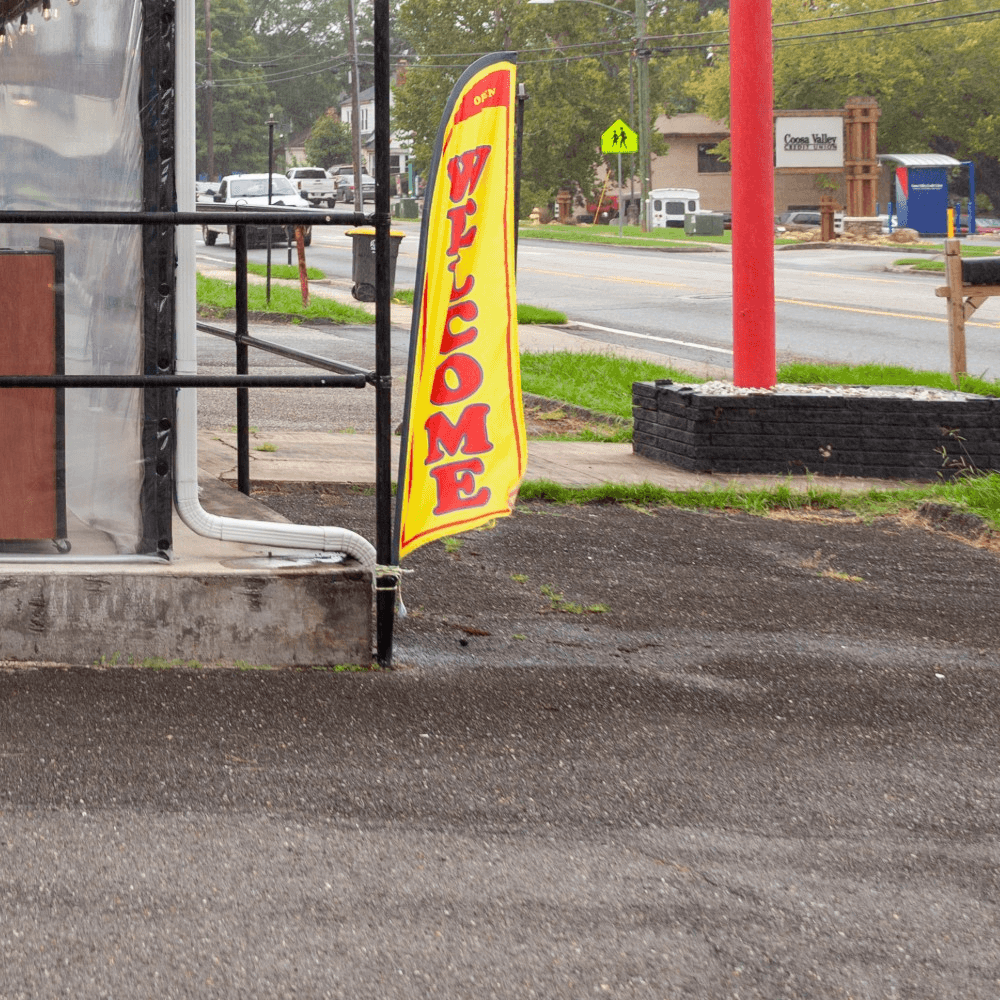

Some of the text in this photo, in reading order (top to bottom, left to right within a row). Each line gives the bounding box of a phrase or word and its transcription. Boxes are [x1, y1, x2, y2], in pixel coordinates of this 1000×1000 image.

[473, 87, 497, 106] OPEN
[784, 133, 837, 144] Coosa Valley
